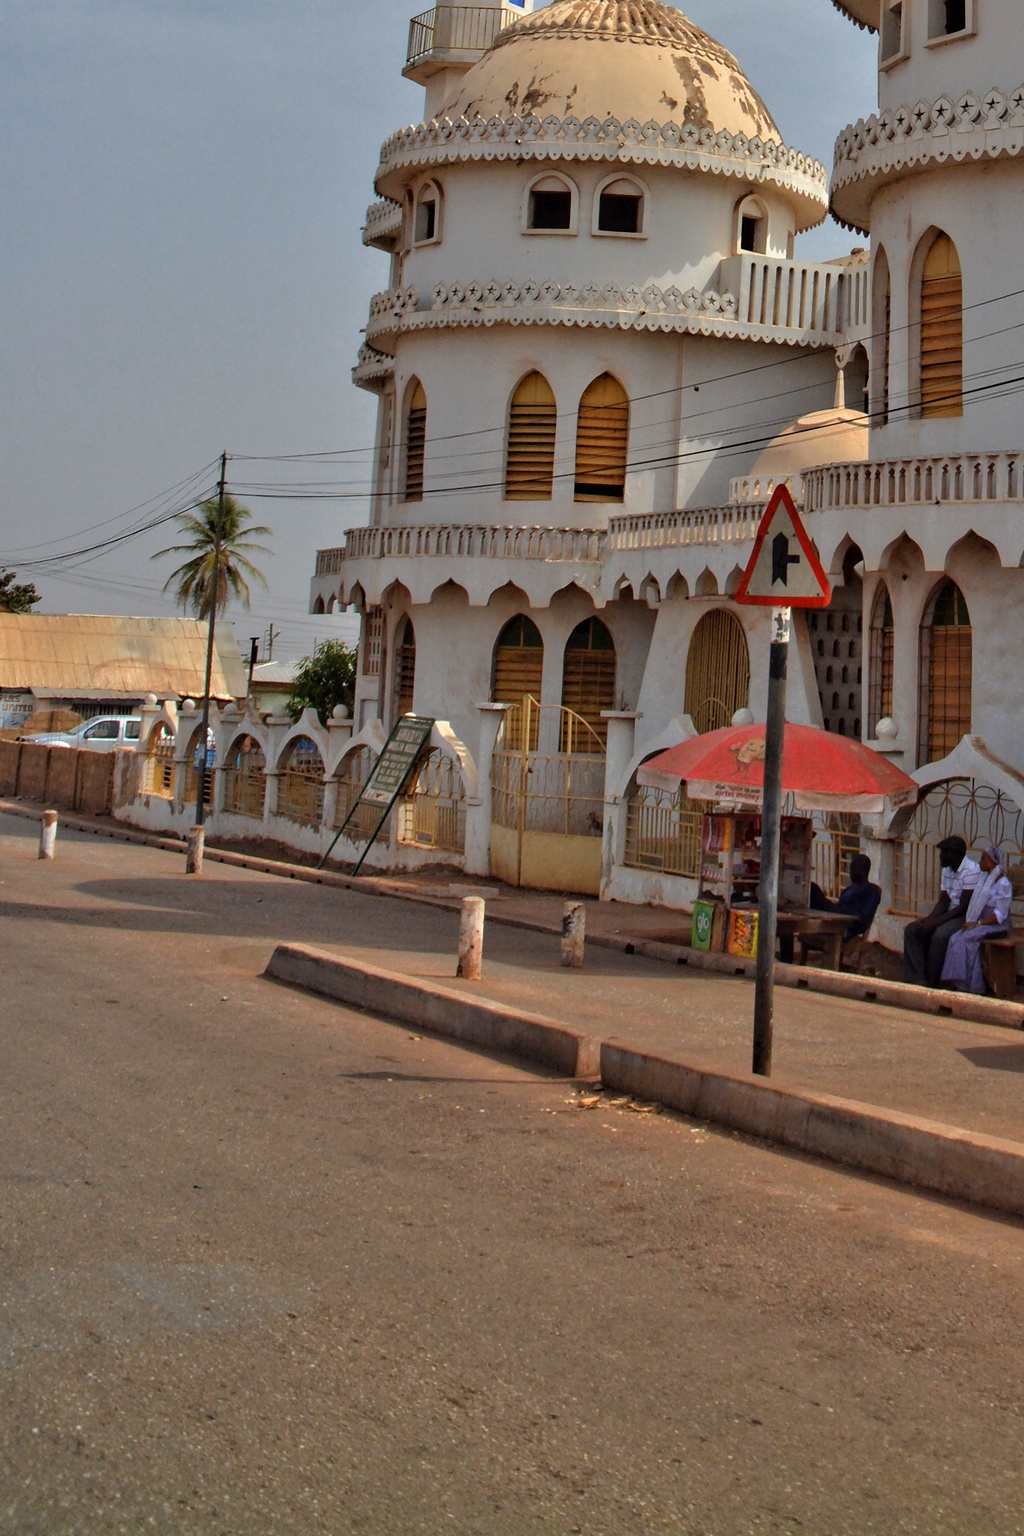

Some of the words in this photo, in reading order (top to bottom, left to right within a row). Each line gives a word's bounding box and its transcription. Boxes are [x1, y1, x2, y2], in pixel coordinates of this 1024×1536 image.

[715, 790, 735, 798] airtel
[736, 792, 760, 802] money
[697, 912, 709, 933] glo
